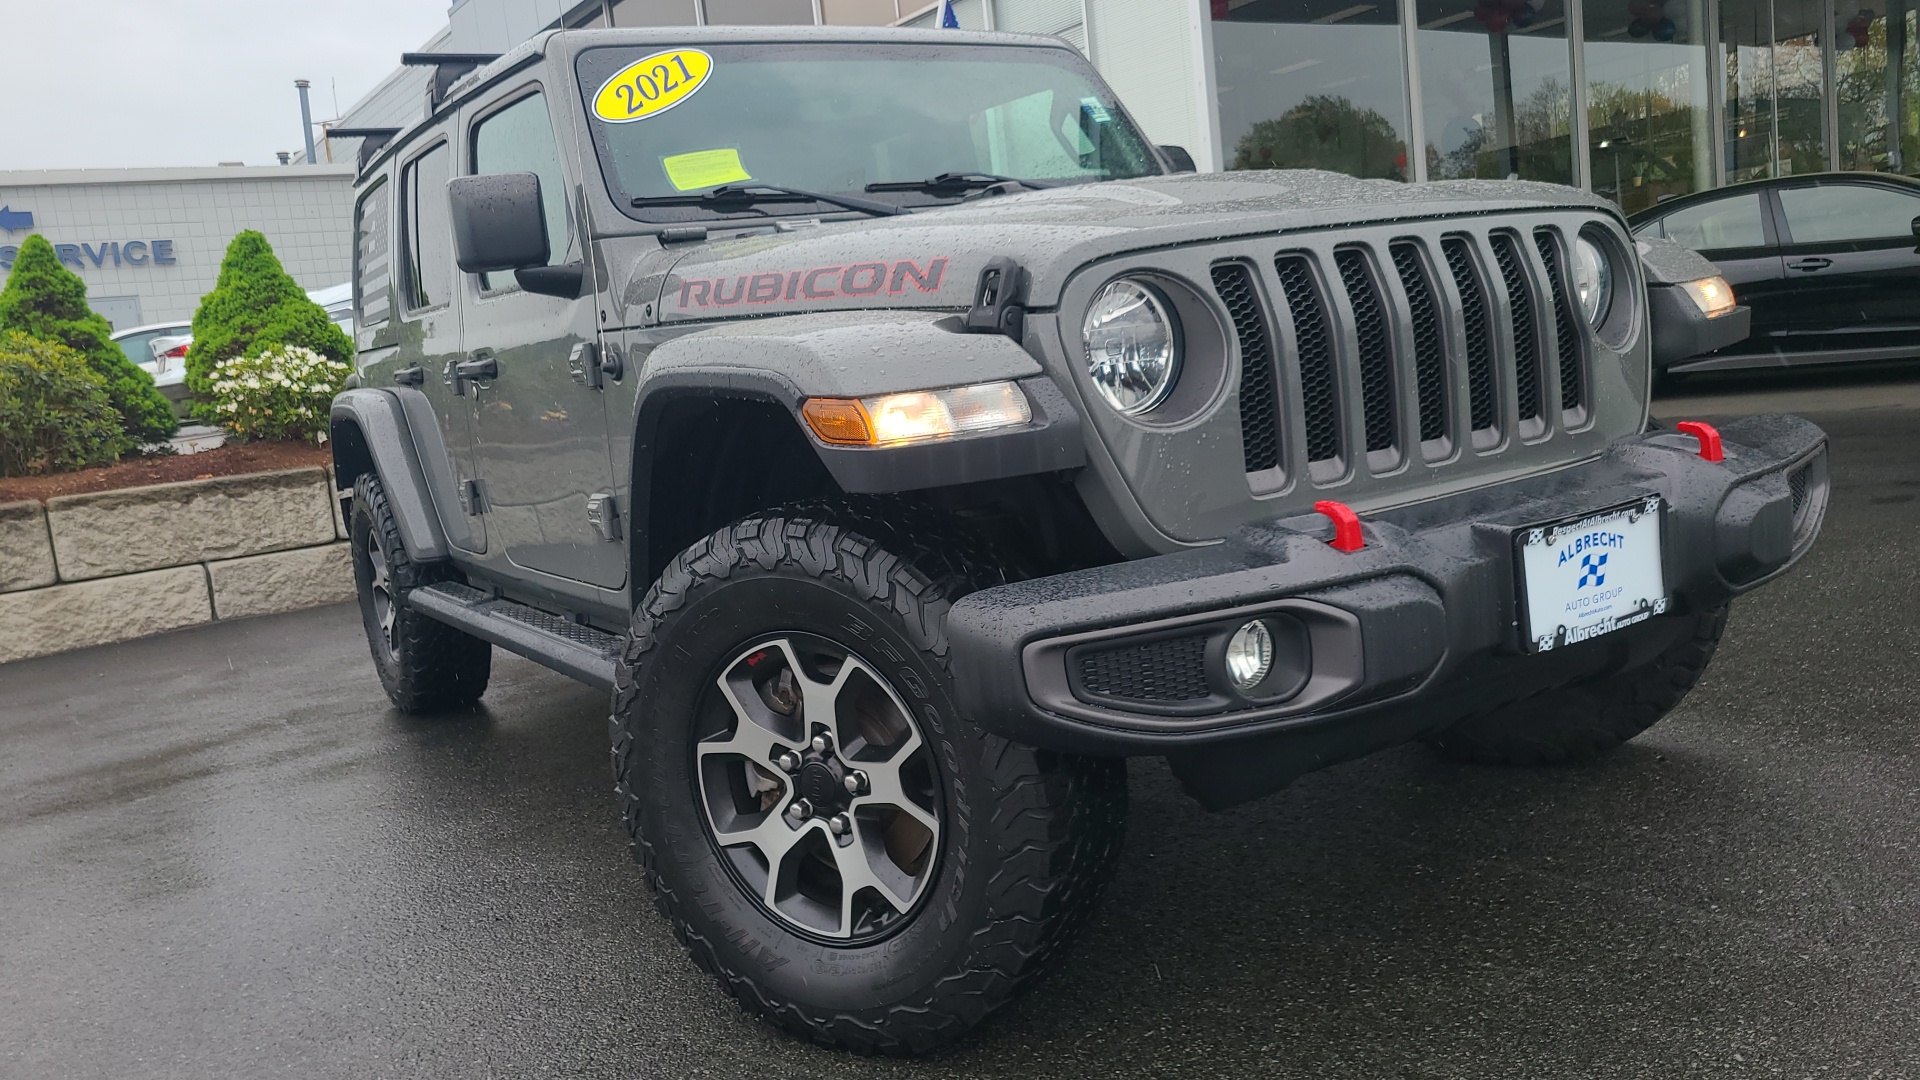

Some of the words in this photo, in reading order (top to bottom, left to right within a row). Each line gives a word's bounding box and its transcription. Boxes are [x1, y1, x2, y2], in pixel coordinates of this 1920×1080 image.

[615, 55, 696, 115] 2021
[0, 240, 176, 270] SRVICE
[678, 256, 949, 309] RUBICON
[1558, 532, 1625, 568] ALBRECHT
[1565, 597, 1590, 613] AUTO
[1592, 586, 1623, 604] GROUP
[1563, 615, 1617, 646] Albrecht
[1616, 618, 1631, 630] AUTO
[1631, 611, 1650, 624] GROUP
